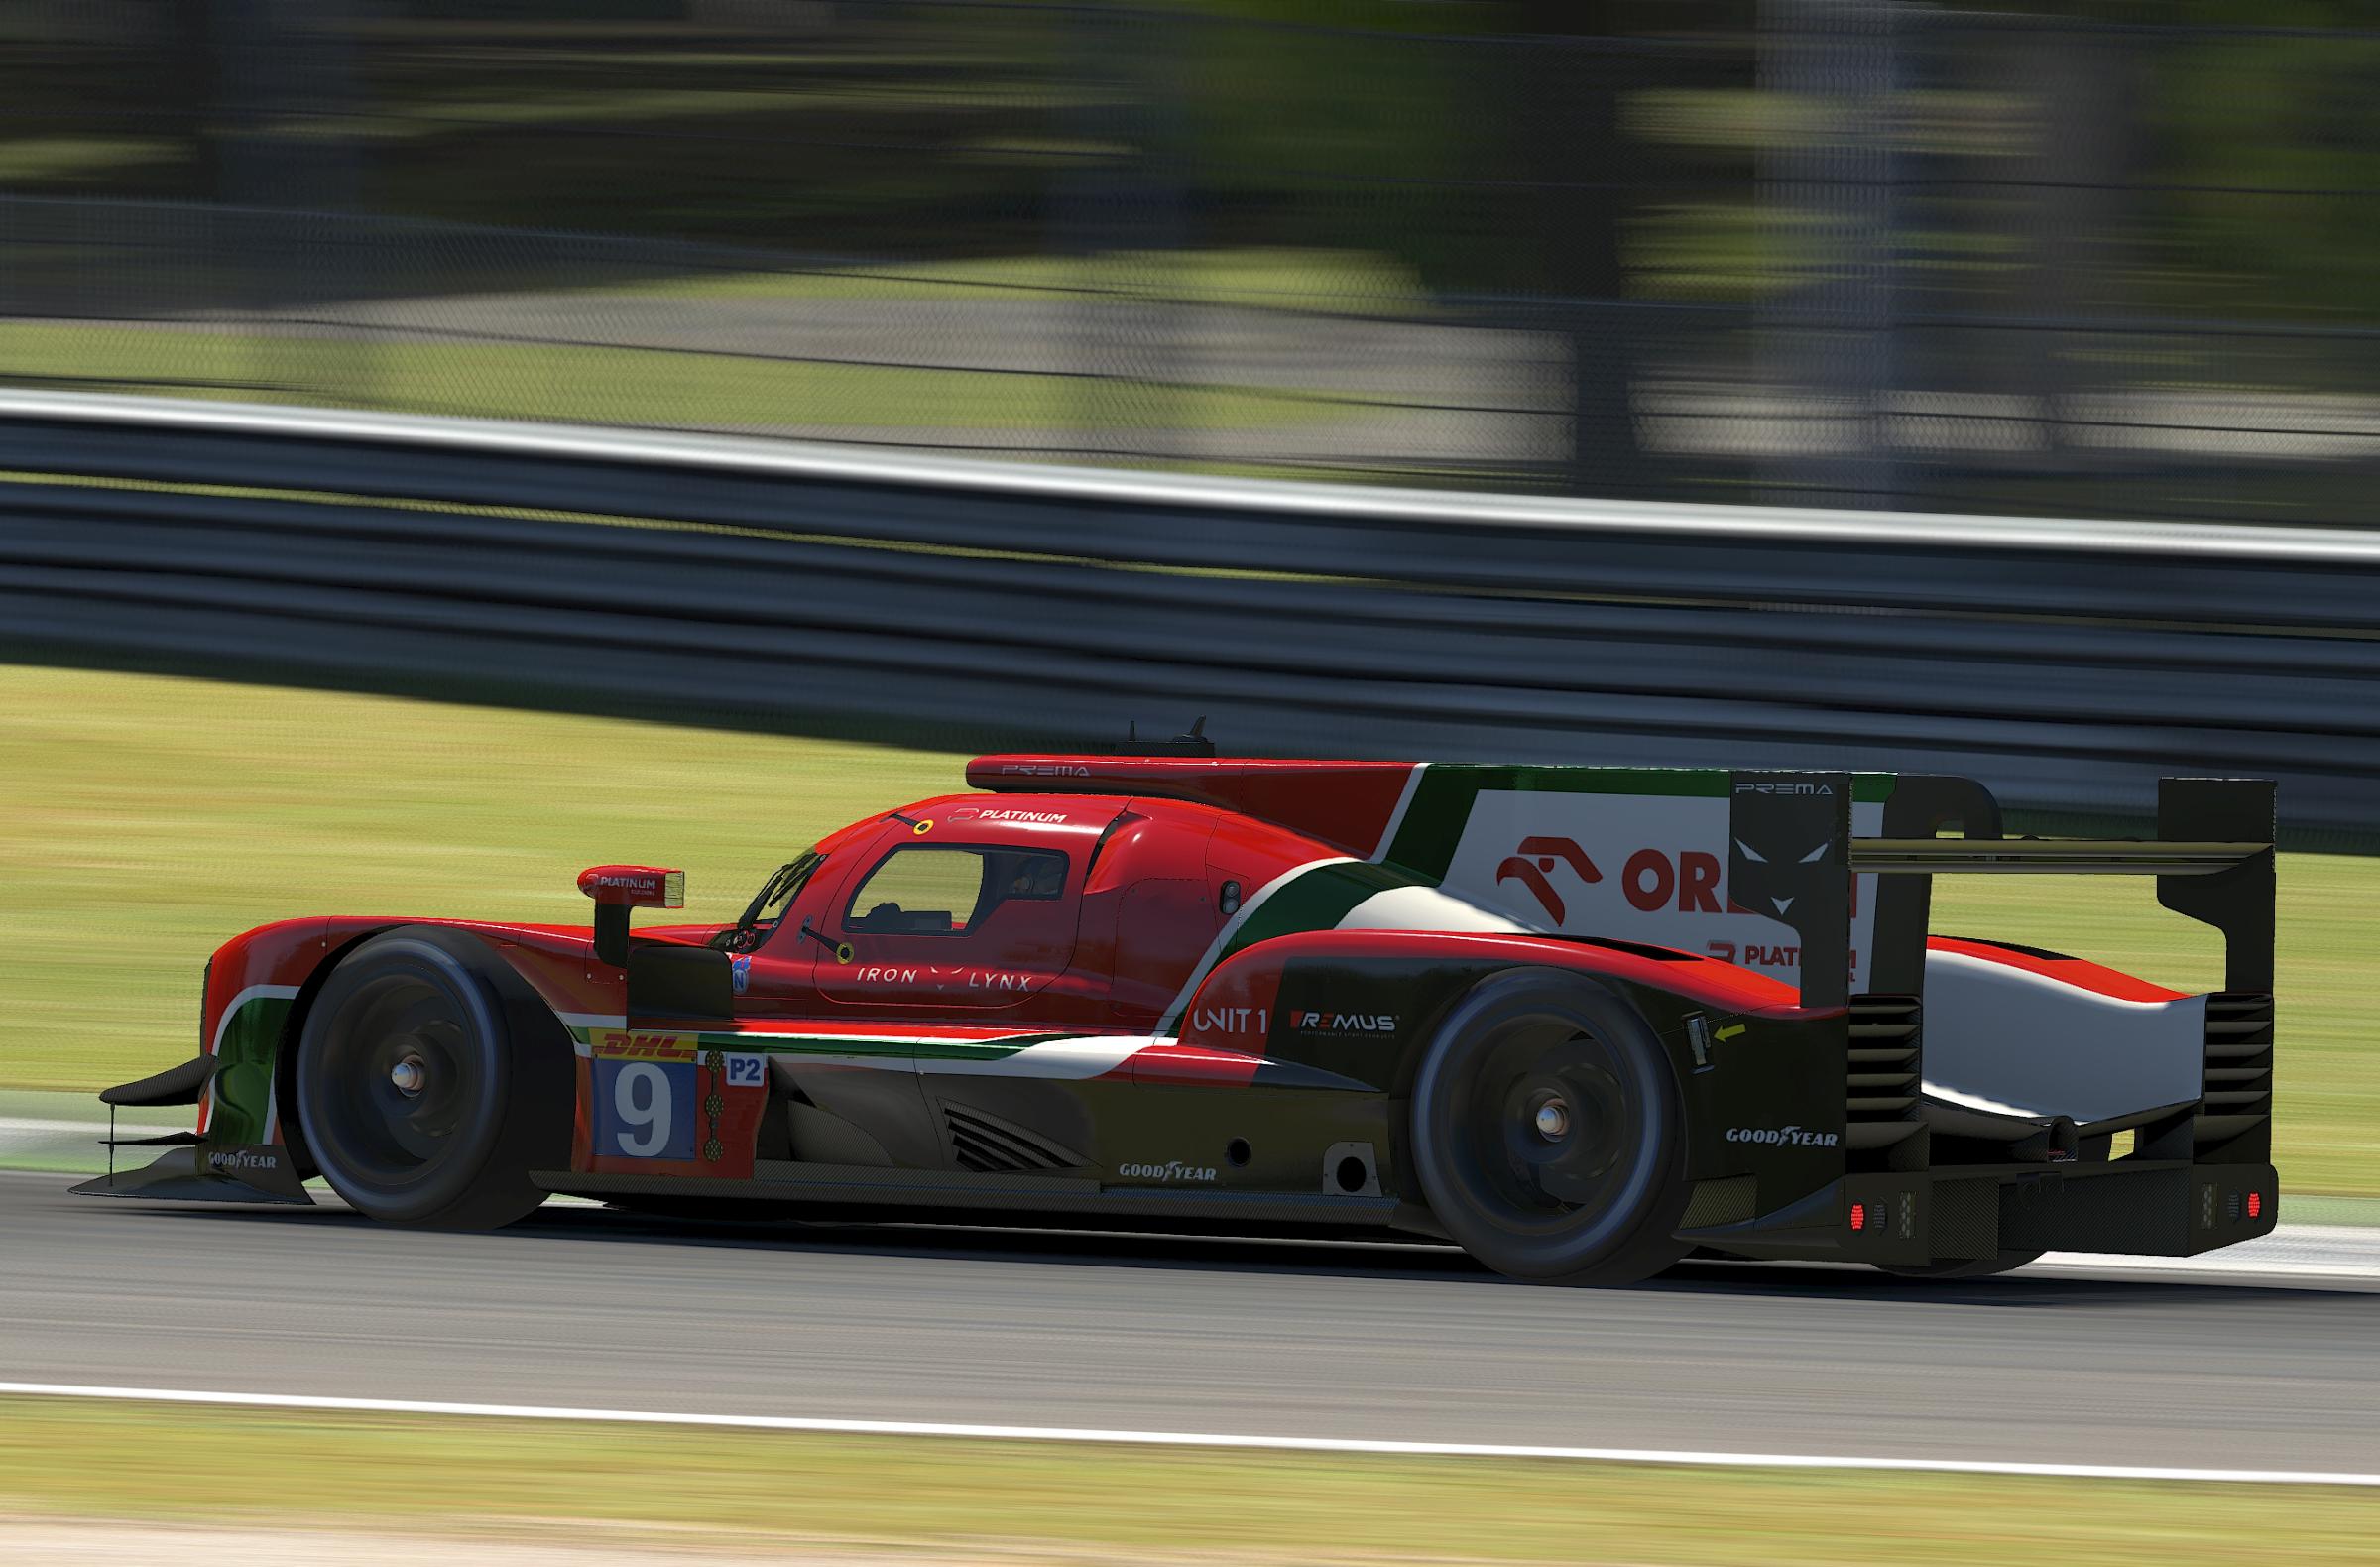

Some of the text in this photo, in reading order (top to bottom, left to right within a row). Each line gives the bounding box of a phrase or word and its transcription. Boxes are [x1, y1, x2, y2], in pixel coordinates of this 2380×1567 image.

[1002, 764, 1091, 777] PREMA
[1735, 782, 1834, 795] PREMA
[979, 809, 1068, 824] PLATINUM
[600, 876, 656, 889] PLATINUM
[856, 967, 1033, 992] IRON LYNX
[1193, 1007, 1267, 1034] UNIT 1
[1300, 1011, 1396, 1031] REMUS
[603, 1033, 684, 1058] DHL
[729, 1058, 761, 1082] P2
[614, 1061, 673, 1157] 9
[1726, 1125, 1839, 1147] GOODYEAR
[207, 1150, 277, 1169] GOODYEAR
[1119, 1160, 1217, 1182] GOODYEAR
